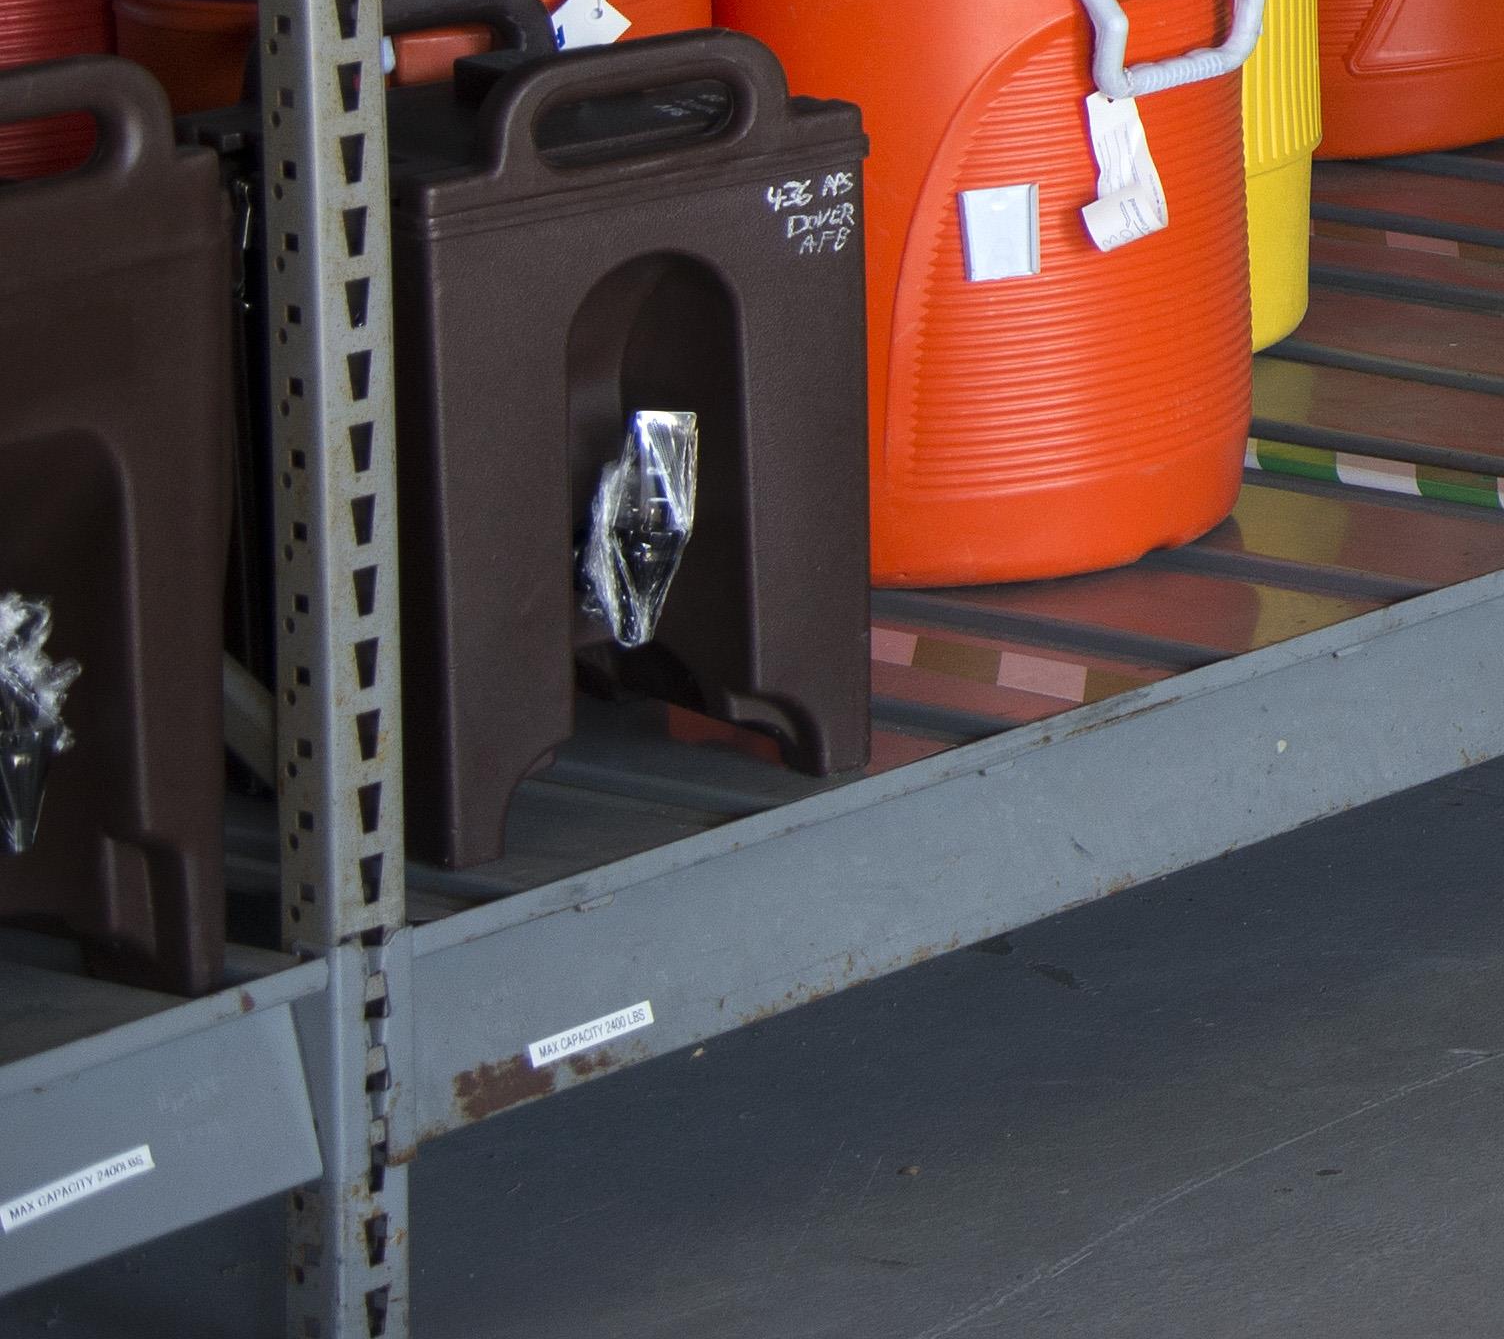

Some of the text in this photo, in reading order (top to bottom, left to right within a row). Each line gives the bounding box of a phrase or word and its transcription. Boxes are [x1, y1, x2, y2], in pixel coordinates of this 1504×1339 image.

[538, 1007, 646, 1059] MAX CAPACITY 2400 LBS
[9, 1201, 35, 1221] MAX
[38, 1175, 94, 1208] CAPACITY
